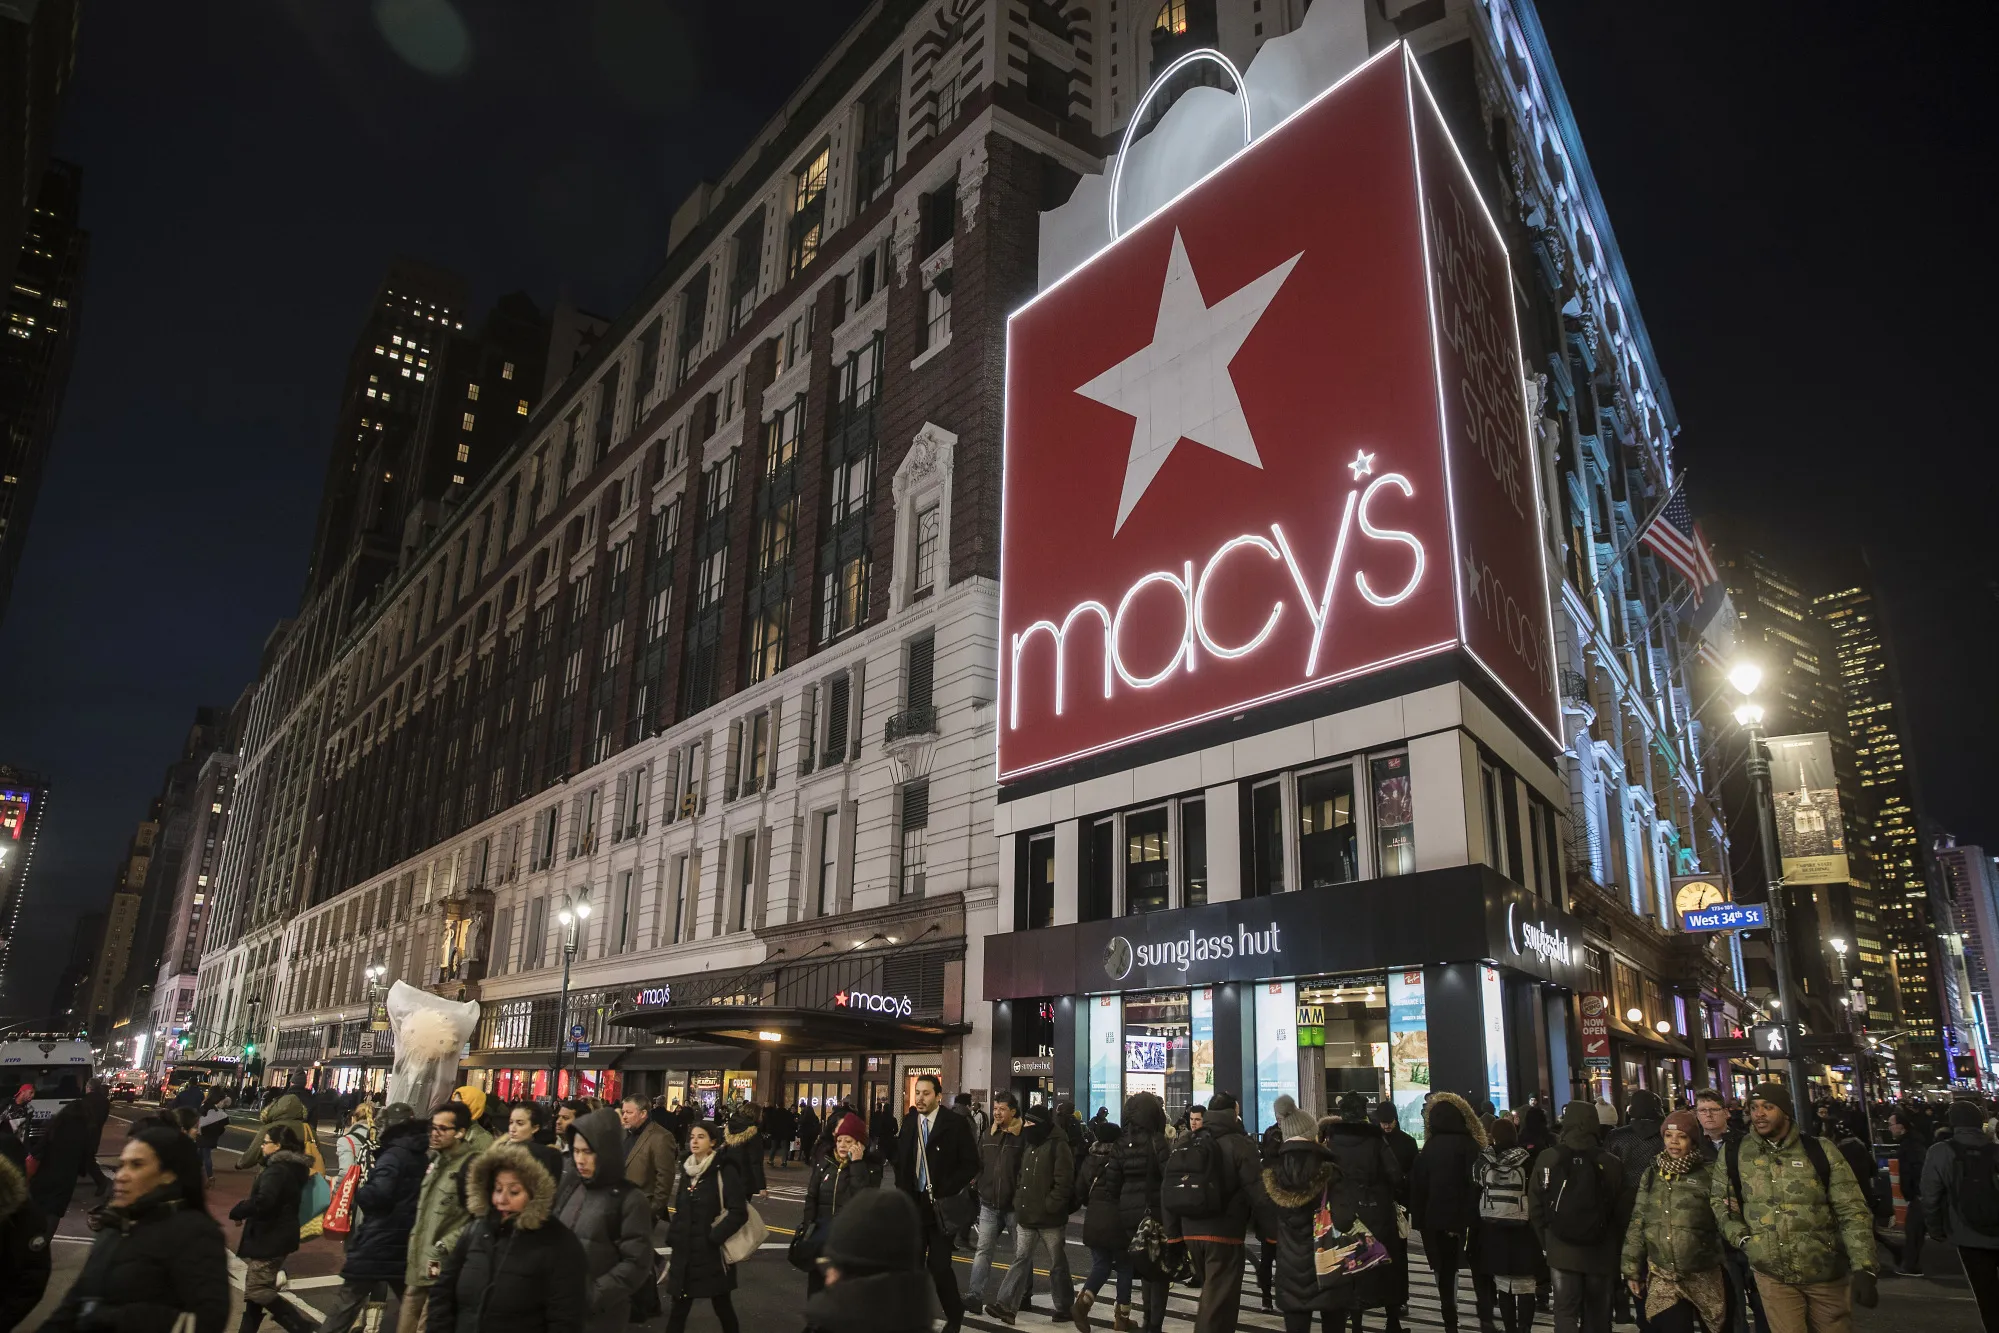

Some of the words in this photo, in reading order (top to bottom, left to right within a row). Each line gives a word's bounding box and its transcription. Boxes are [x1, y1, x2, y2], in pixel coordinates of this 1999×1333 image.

[1449, 185, 1491, 300] THE
[1437, 272, 1522, 460] LARGEST
[1461, 378, 1525, 520] STORE
[1689, 914, 1720, 926] West
[1721, 911, 1743, 924] 34th
[1746, 911, 1759, 922] St
[1137, 929, 1234, 971] sunglass
[1238, 922, 1281, 956] hut
[1583, 1027, 1607, 1035] OPEN
[1584, 1019, 1604, 1027] NOW
[908, 1067, 921, 1076] LOUIS
[921, 1067, 941, 1076] VUITTON
